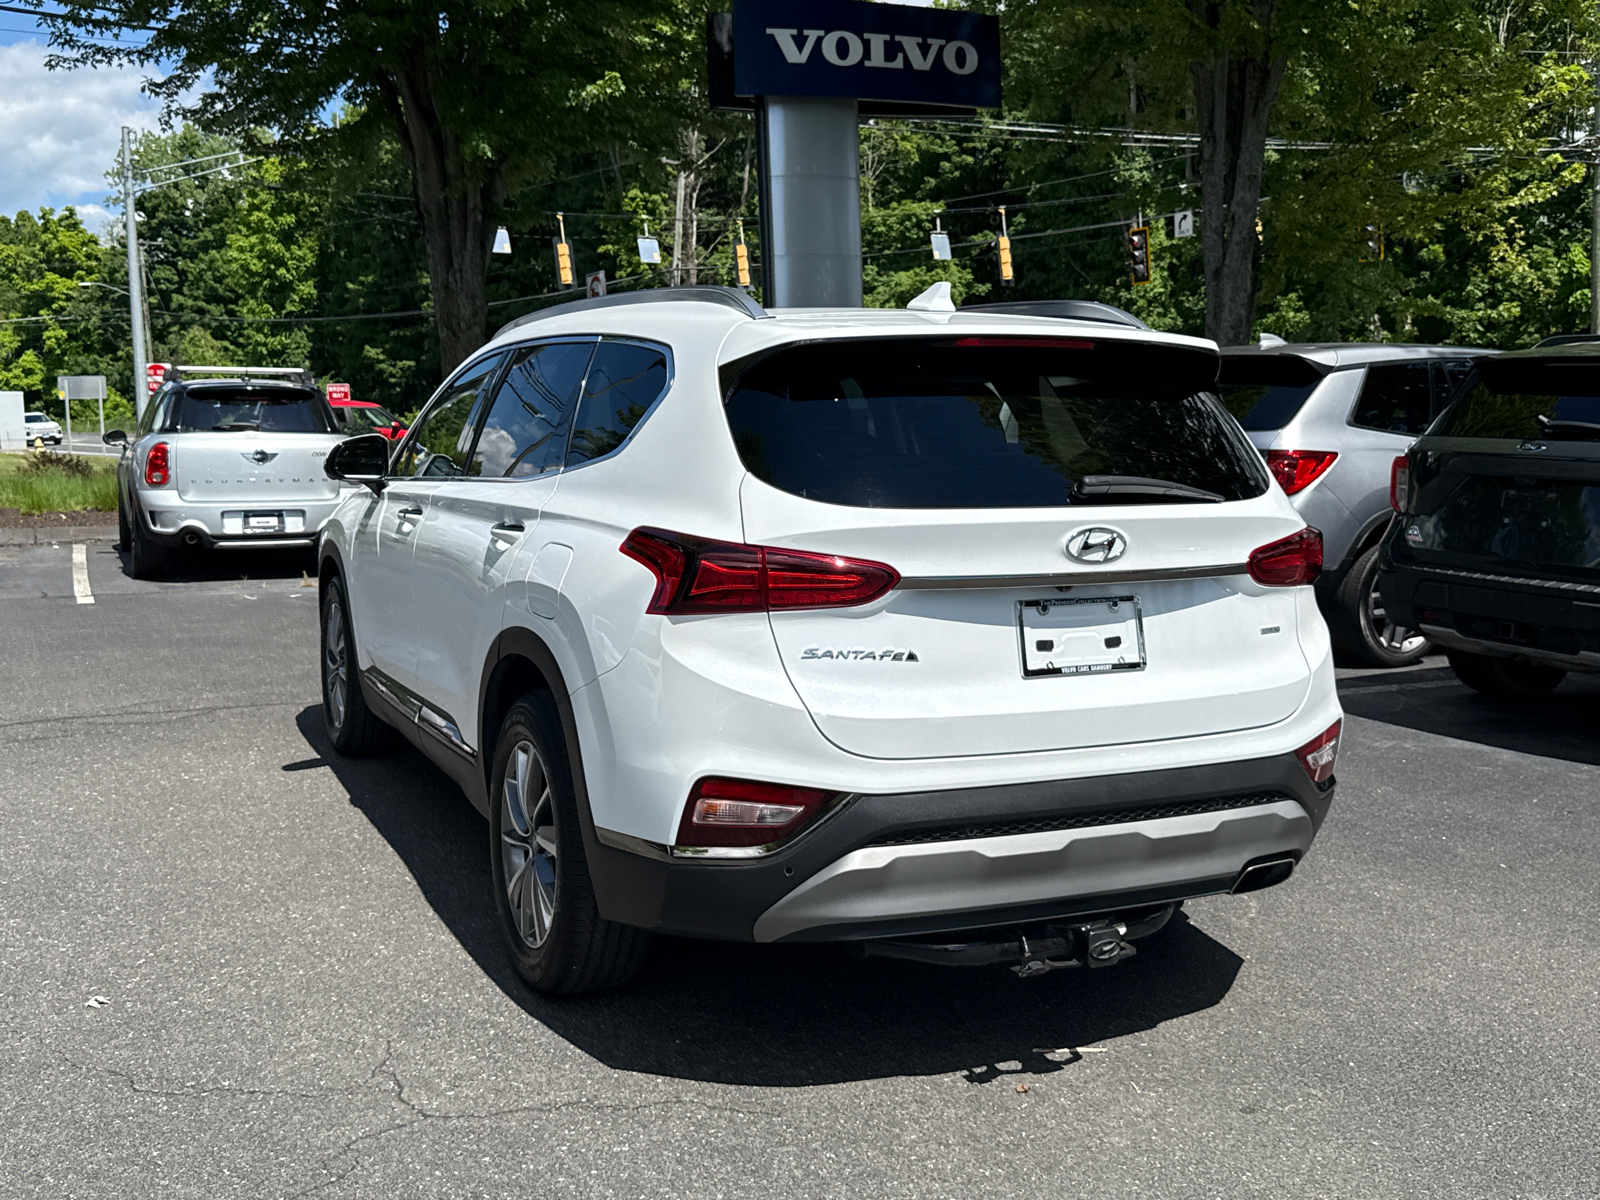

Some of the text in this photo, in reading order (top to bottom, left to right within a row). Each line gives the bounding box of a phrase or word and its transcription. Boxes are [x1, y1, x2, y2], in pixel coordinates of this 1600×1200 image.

[765, 28, 979, 75] VOLVO
[1061, 666, 1076, 674] VOLVO
[1077, 665, 1090, 673] CARS
